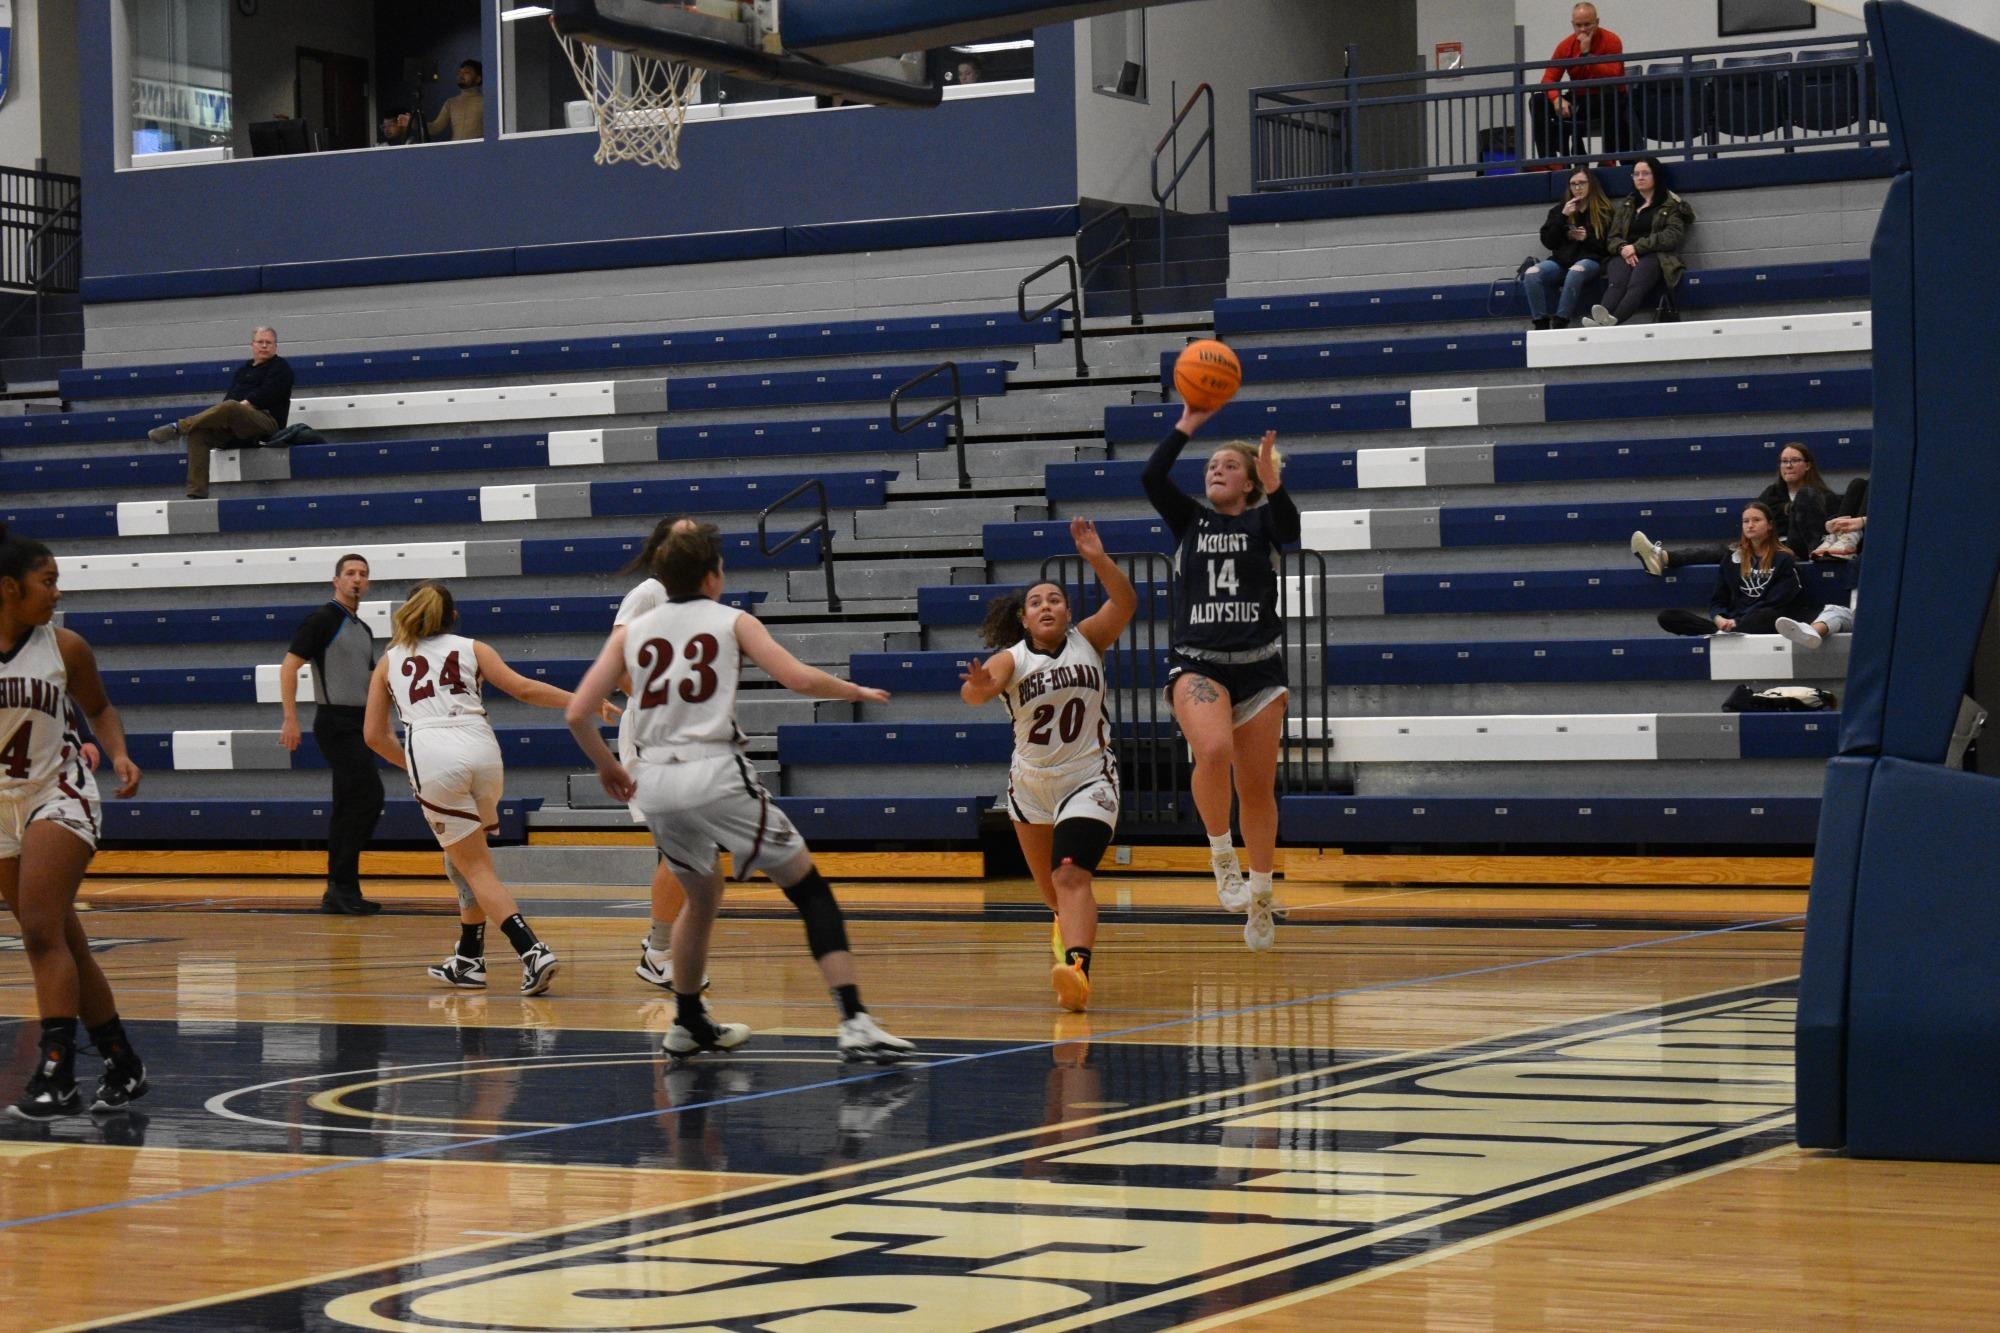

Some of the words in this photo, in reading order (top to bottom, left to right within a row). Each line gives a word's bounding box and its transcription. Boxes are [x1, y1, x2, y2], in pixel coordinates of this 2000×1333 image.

[1197, 533, 1248, 553] MOUNT
[1207, 558, 1240, 597] 14
[1189, 601, 1261, 625] ALOYSIUS
[401, 651, 467, 705] 24
[637, 633, 719, 710] 23
[1027, 697, 1086, 746] 20
[0, 719, 33, 779] 4
